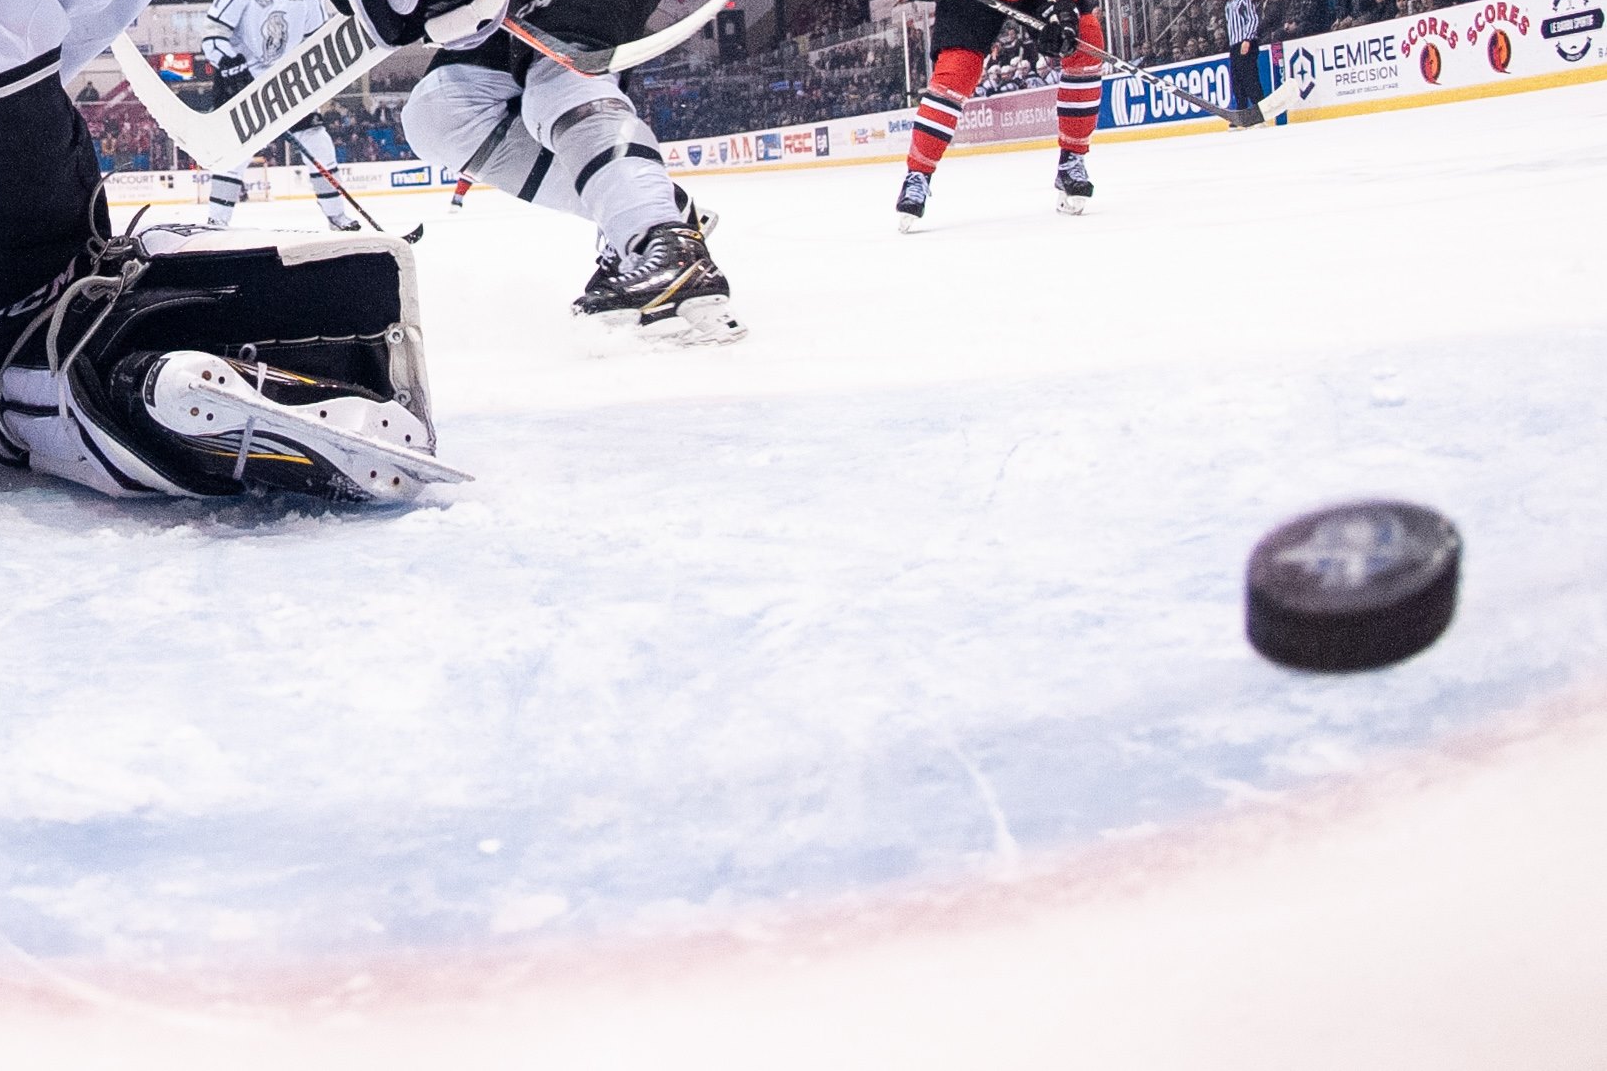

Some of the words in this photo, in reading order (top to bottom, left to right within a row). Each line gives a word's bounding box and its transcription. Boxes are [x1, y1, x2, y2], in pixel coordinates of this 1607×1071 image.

[1401, 16, 1459, 59] SCORES
[1466, 1, 1531, 47] SCORES
[1321, 34, 1396, 72] LEMIRE
[1335, 65, 1398, 87] PRÉCISION
[956, 103, 993, 130] esada
